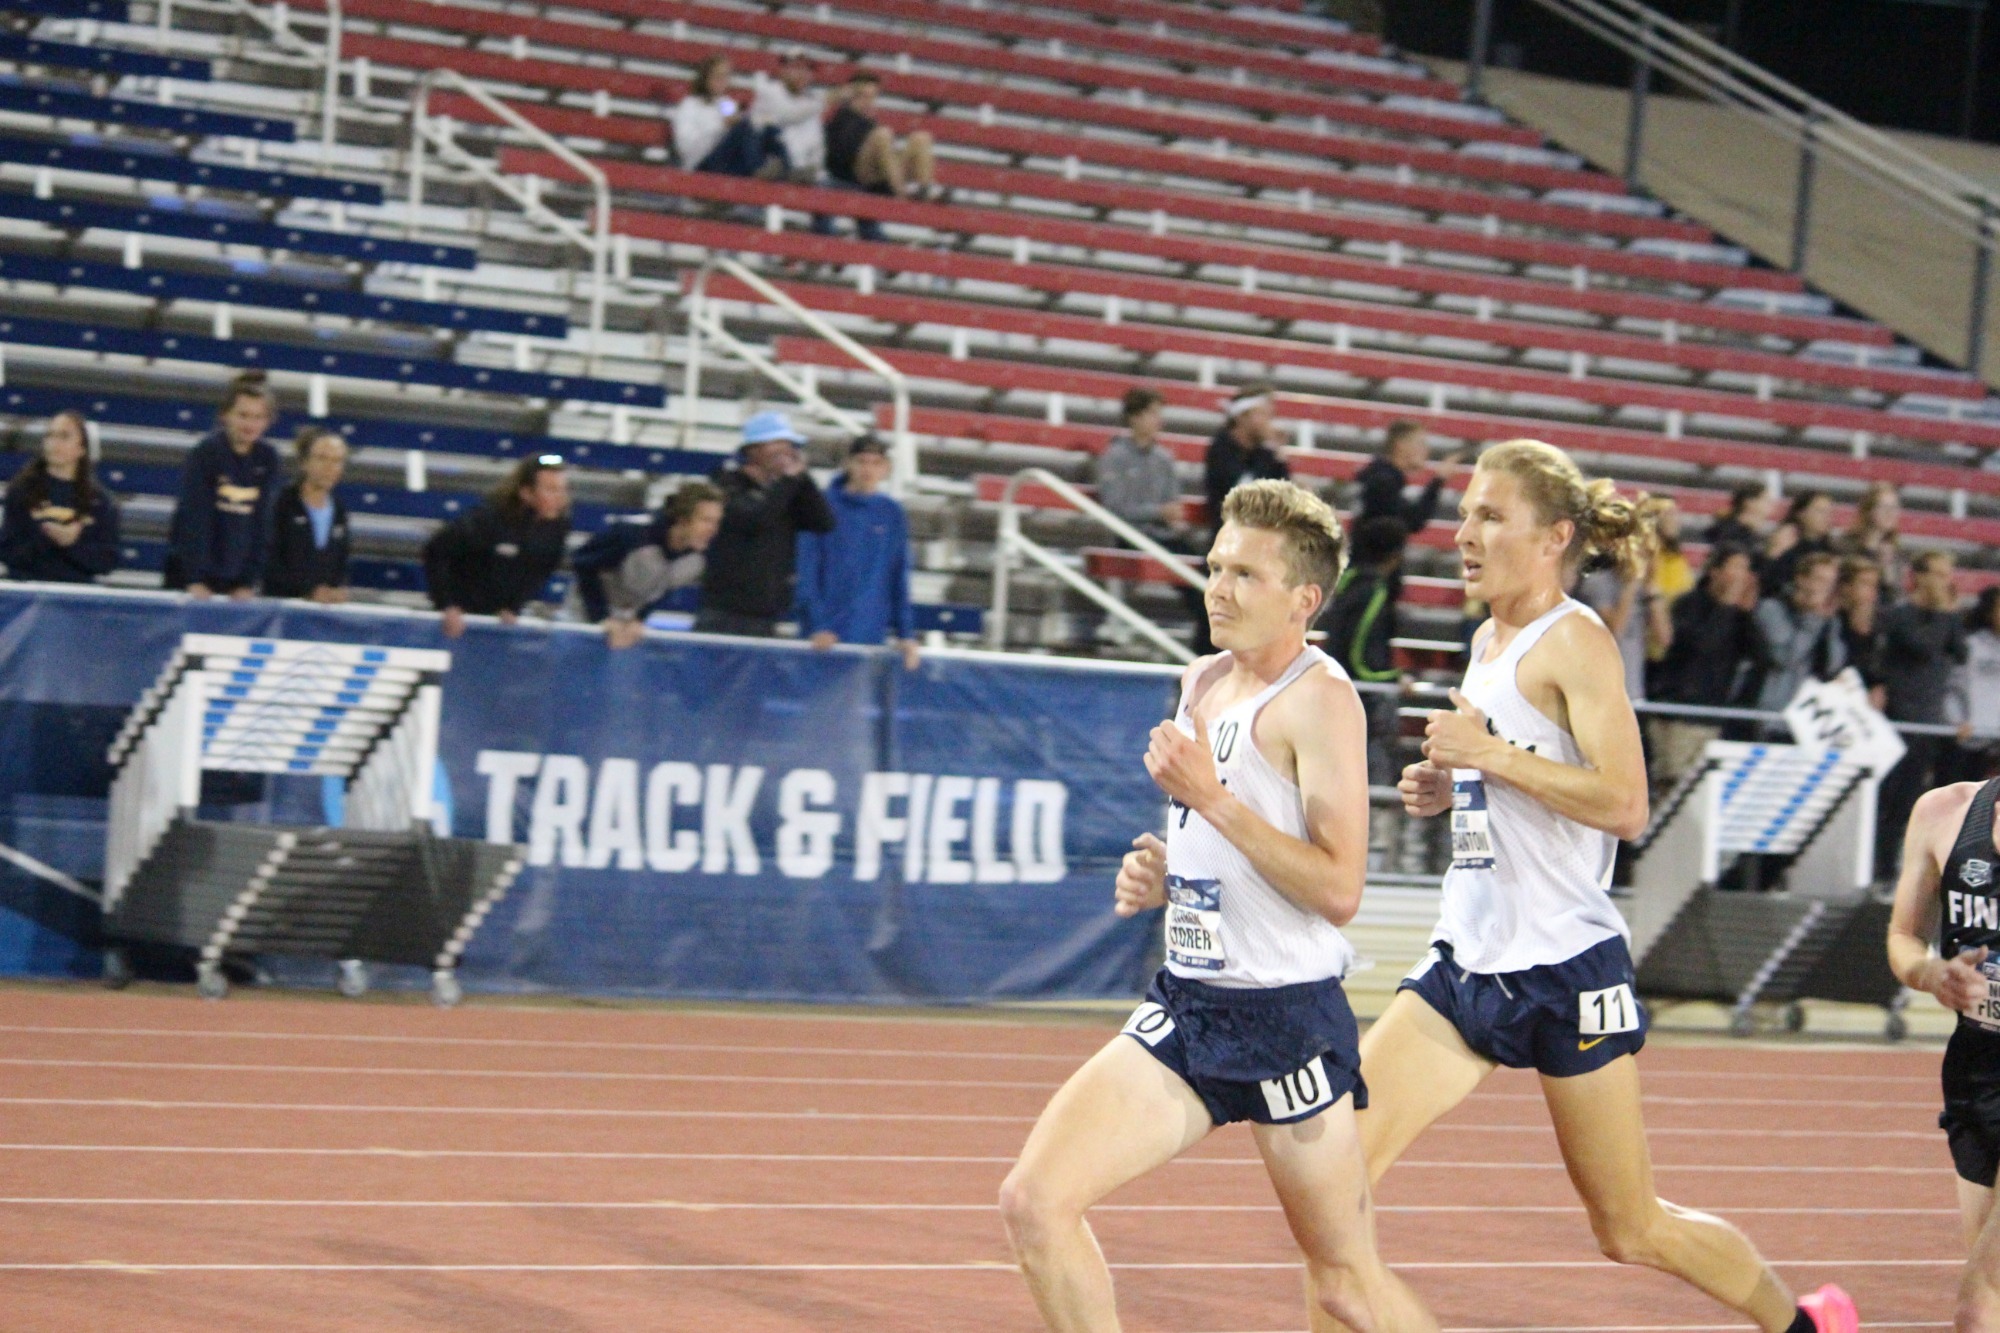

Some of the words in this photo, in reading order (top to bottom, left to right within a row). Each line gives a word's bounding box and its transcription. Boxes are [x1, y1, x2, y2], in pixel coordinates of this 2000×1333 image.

[1212, 720, 1239, 763] 10
[475, 749, 764, 876] TRACK
[775, 768, 842, 878] &
[853, 771, 1068, 884] FIELD
[1948, 889, 2000, 931] FIN
[1592, 988, 1626, 1031] 11
[1271, 1065, 1320, 1112] 10
